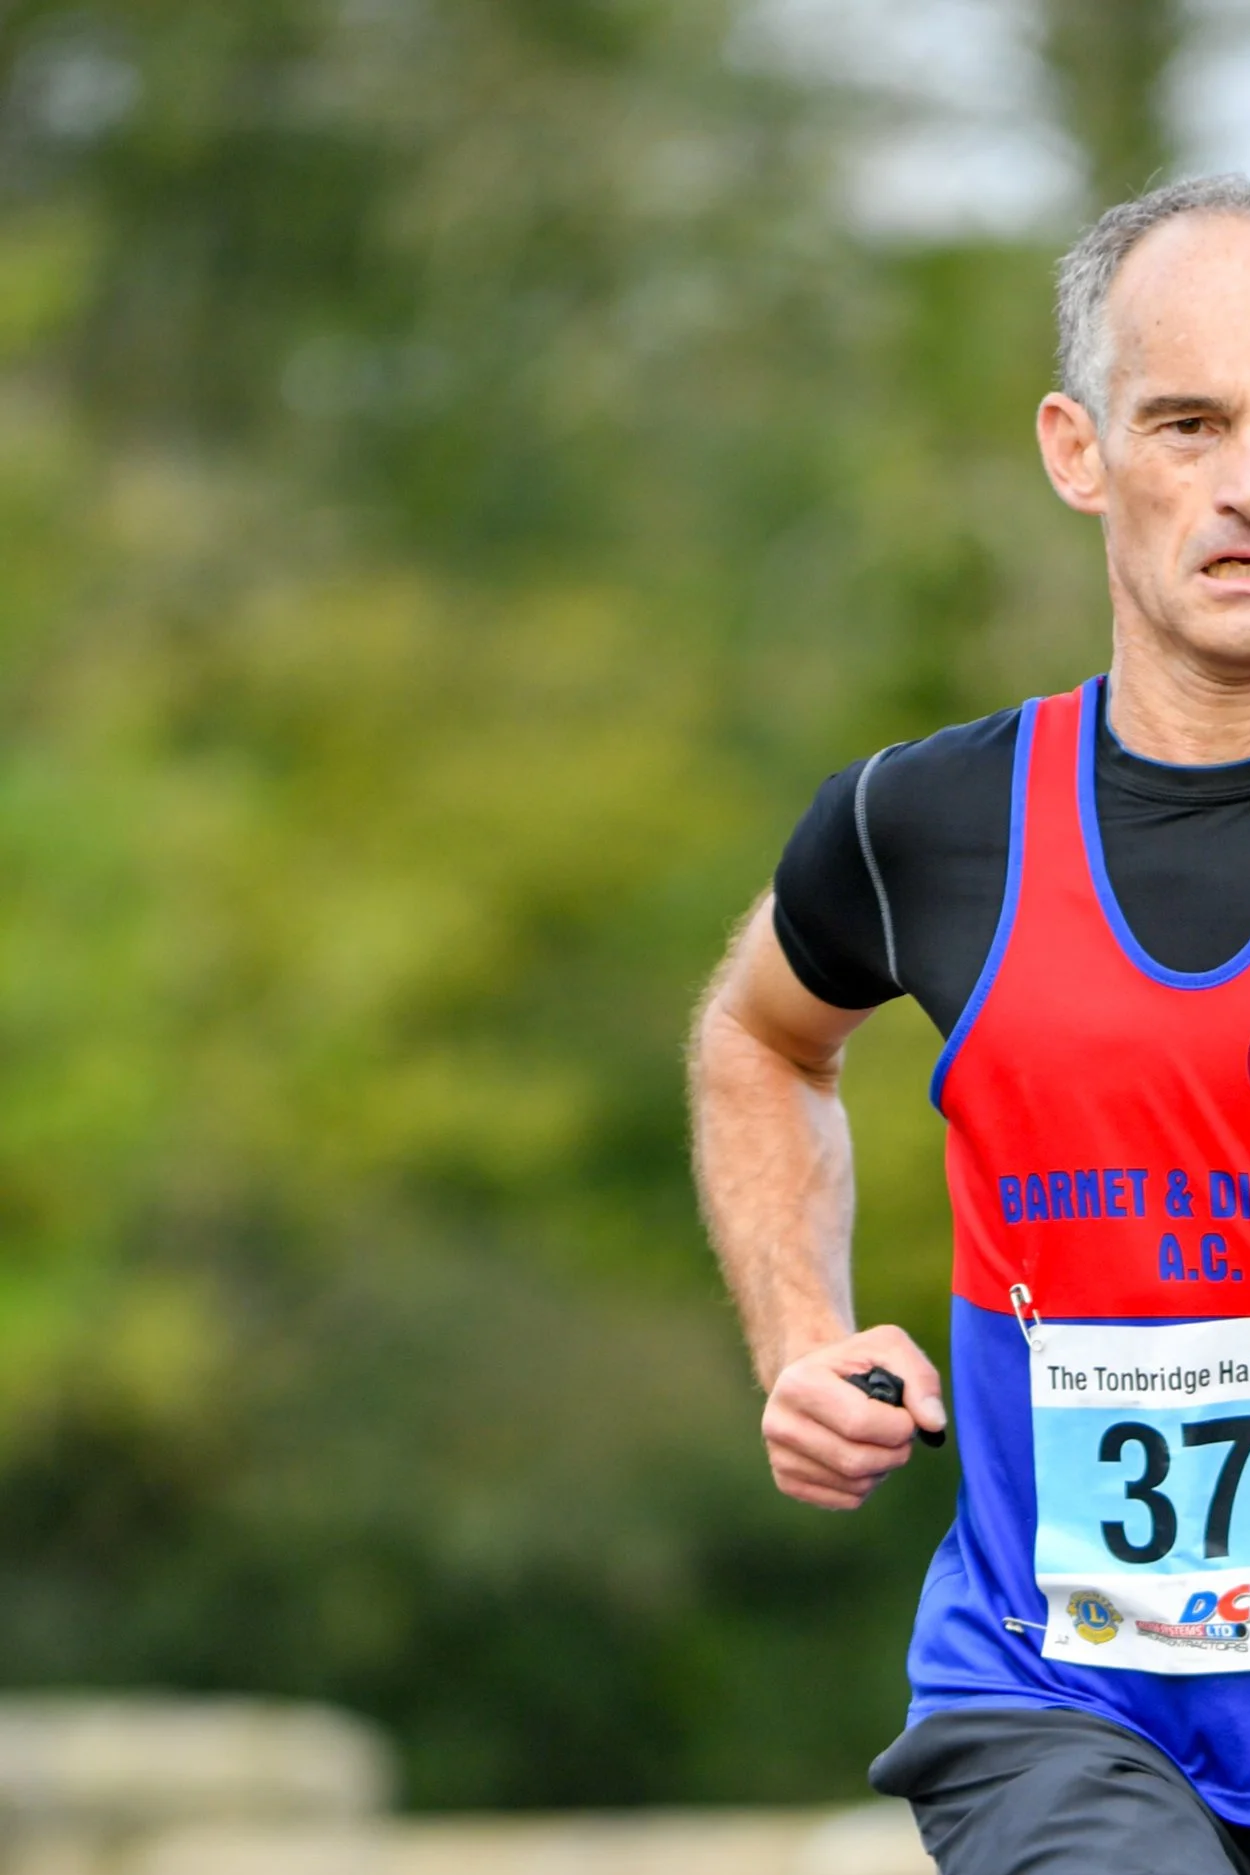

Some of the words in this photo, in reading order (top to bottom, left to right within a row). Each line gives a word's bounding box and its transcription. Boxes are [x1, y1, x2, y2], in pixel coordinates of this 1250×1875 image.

[998, 1168, 1148, 1224] BARNET
[1165, 1168, 1194, 1219] &
[1158, 1232, 1243, 1282] A.C.
[1047, 1365, 1088, 1391] The
[1095, 1365, 1211, 1395] Tonbridge
[1205, 1625, 1233, 1637] LTD
